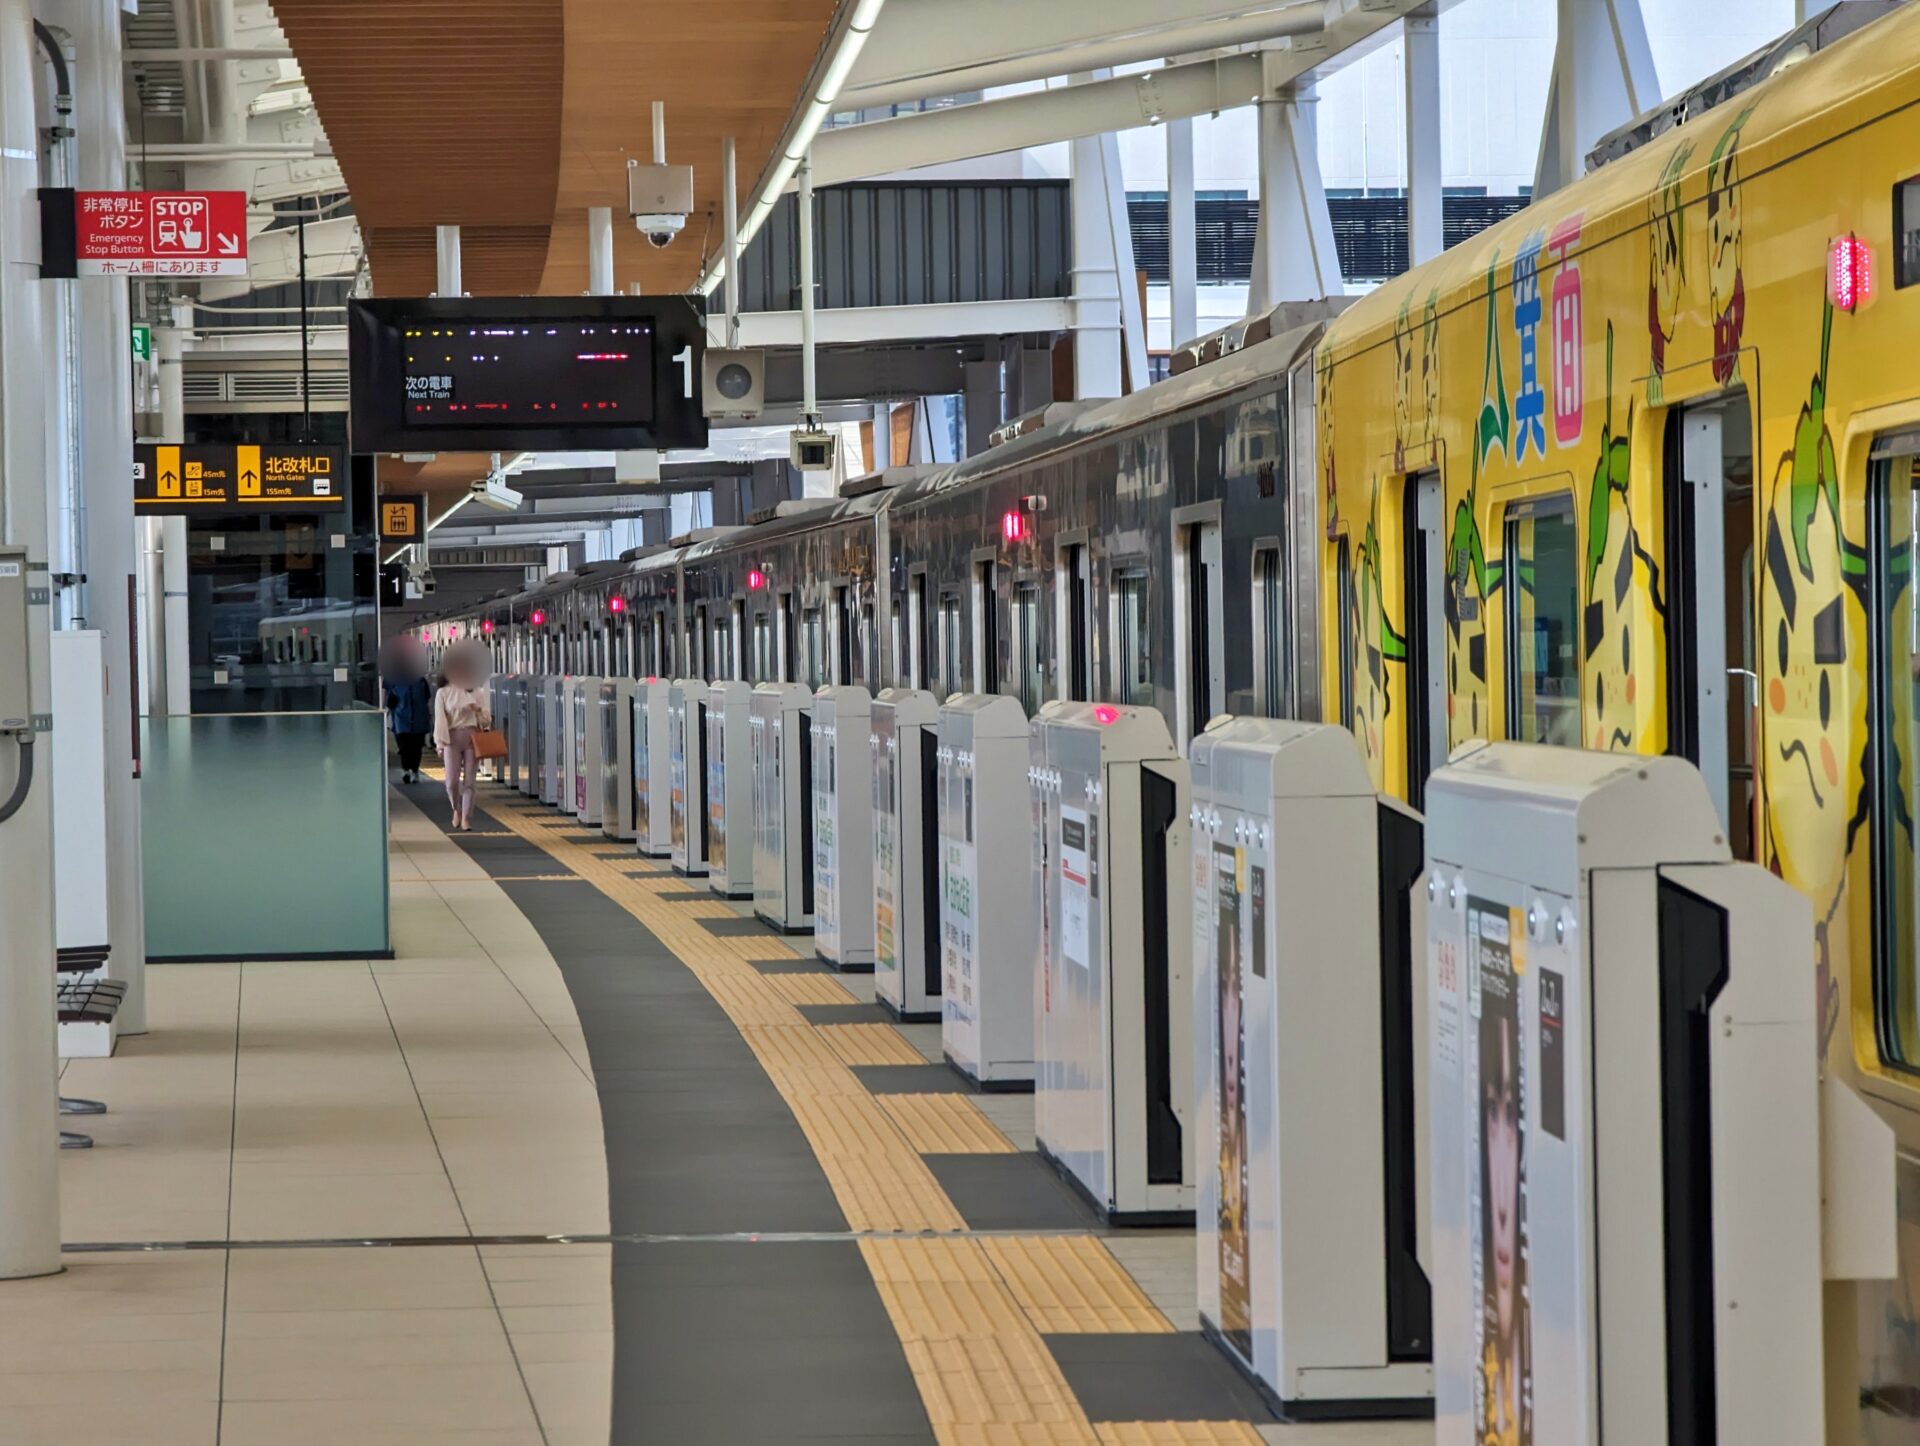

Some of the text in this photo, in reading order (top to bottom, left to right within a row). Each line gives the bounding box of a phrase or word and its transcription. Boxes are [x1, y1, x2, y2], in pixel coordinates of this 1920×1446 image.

[83, 197, 144, 213] 非常停止
[156, 201, 204, 216] STOP
[100, 215, 144, 229] ボタン
[90, 234, 144, 244] Emergency
[85, 245, 144, 255] Stop Button
[102, 261, 222, 273] ホーム柵にあります
[672, 345, 693, 398] 1
[405, 376, 453, 391] 次の電車
[408, 390, 451, 400] Next Train
[266, 456, 330, 474] 北改札口
[266, 474, 285, 482] North
[391, 577, 399, 594] 1
